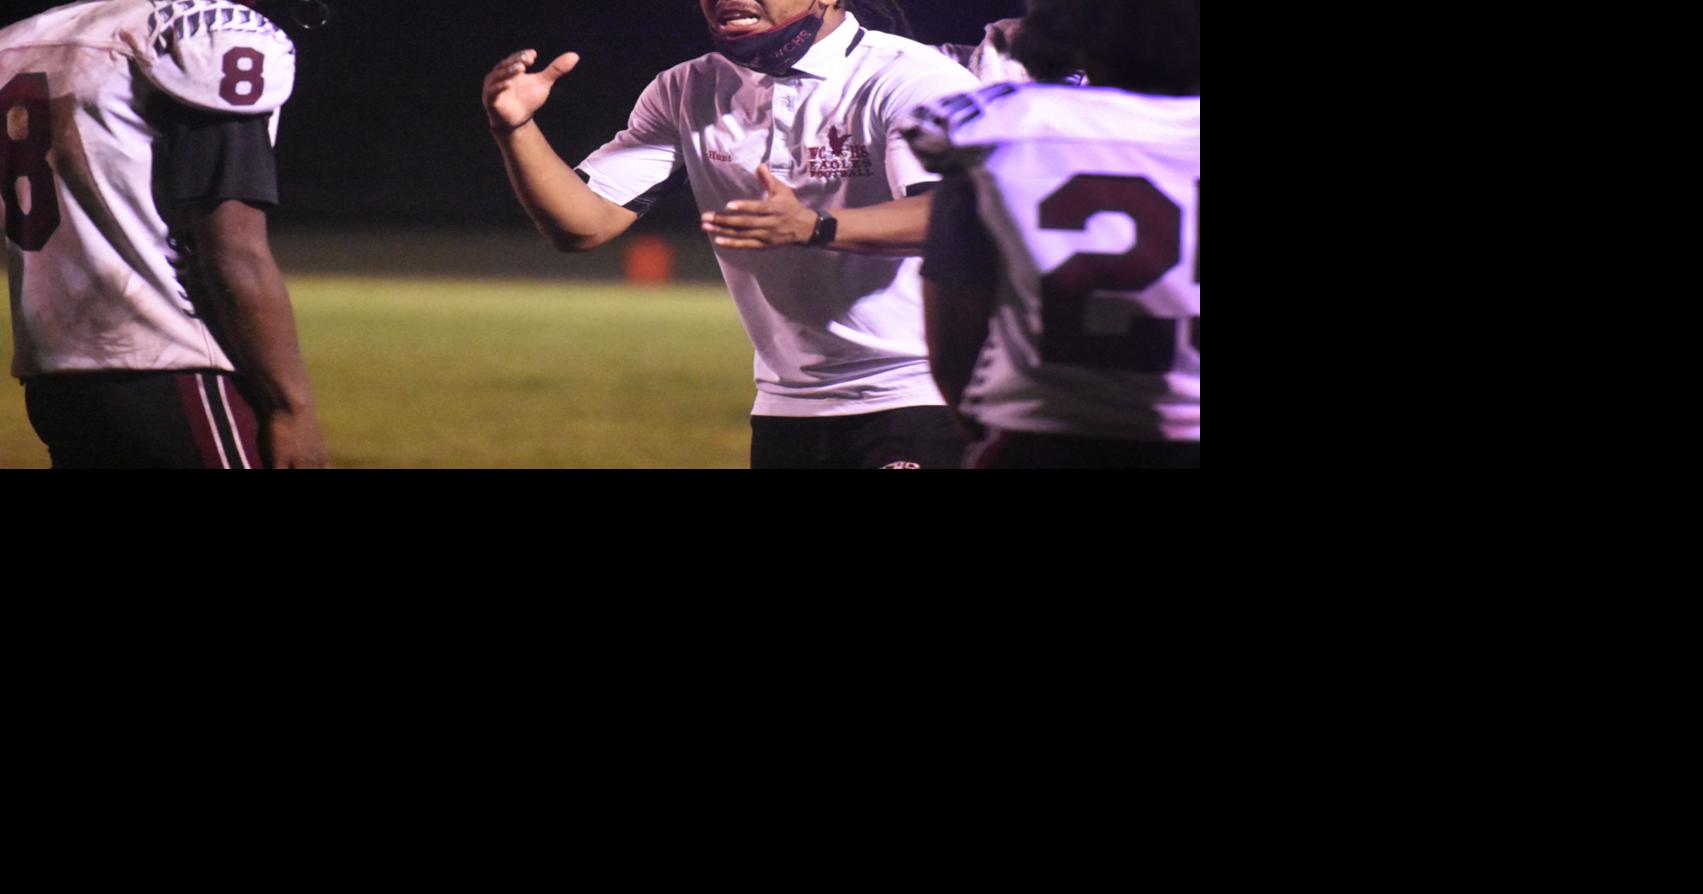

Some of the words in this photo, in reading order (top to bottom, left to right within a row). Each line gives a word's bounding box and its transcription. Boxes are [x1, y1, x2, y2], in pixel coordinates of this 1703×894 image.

[219, 47, 265, 106] 8
[0, 72, 60, 251] 8
[809, 160, 872, 170] EAGLES
[809, 170, 873, 178] FOOTBALL
[1037, 174, 1200, 371] 2
